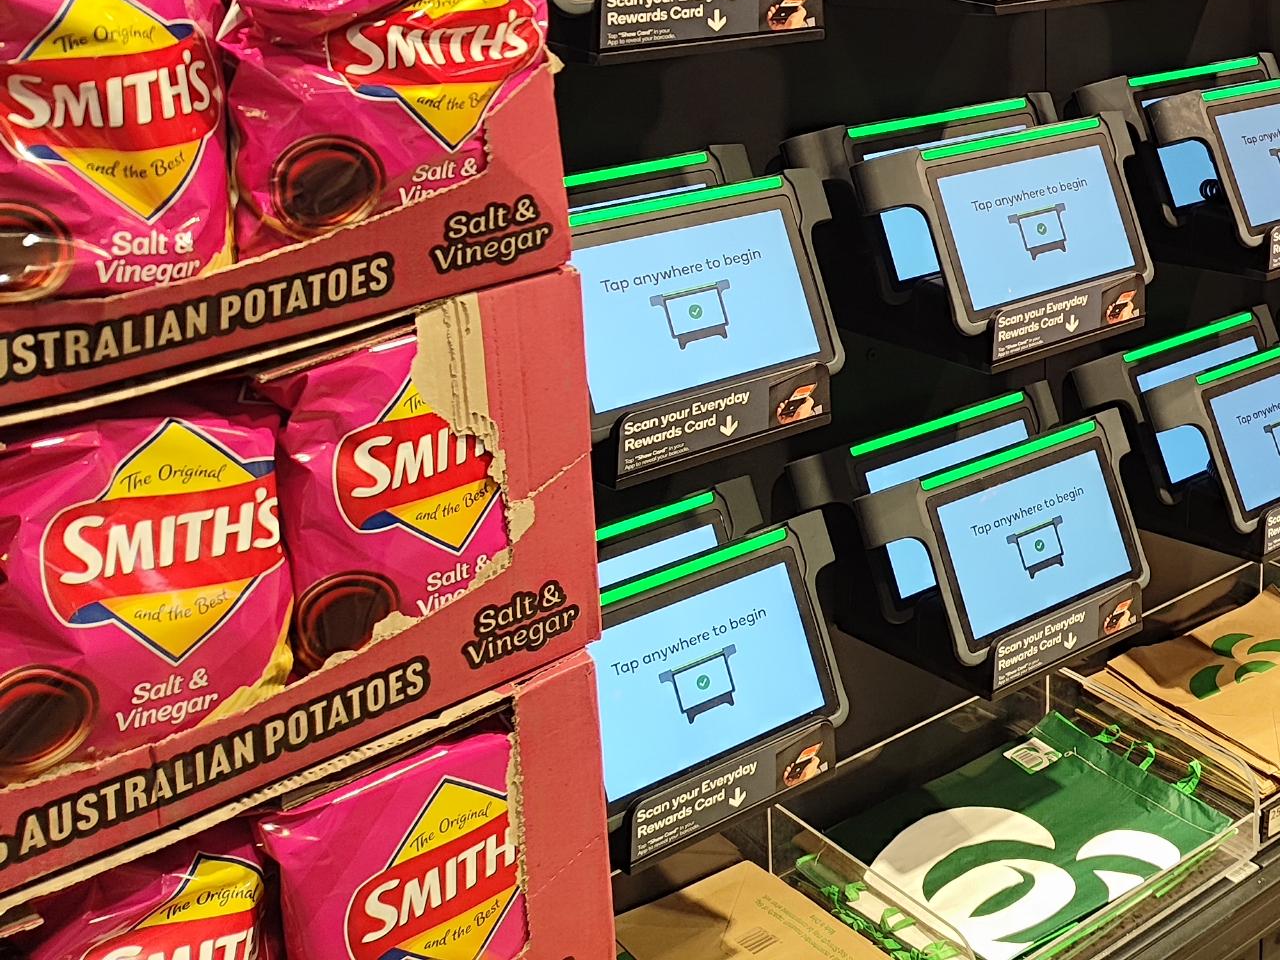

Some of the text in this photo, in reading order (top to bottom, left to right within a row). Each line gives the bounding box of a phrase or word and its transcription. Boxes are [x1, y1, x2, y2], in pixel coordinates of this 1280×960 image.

[606, 5, 704, 26] Rewards Card
[53, 25, 156, 54] The Original
[343, 8, 532, 76] SMITH'S
[7, 49, 210, 129] SMITH'S
[416, 94, 446, 110] and
[446, 97, 466, 111] the
[1242, 135, 1258, 146] Tap
[86, 151, 186, 179] and the Best
[412, 158, 478, 182] Salt &
[971, 177, 1088, 213] Tap anywhere to begin
[448, 198, 536, 240] Salt &
[112, 230, 194, 256] Salt &
[434, 227, 552, 272] Vinegar
[96, 258, 200, 286] Vinegar
[600, 248, 762, 294] Tap anywhere to begin
[220, 257, 390, 331] POTATOES
[998, 294, 1088, 328] Scan your Everyday
[998, 314, 1064, 342] Rewards Card
[624, 390, 750, 436] Scan your Everyday
[624, 414, 717, 452] Rewards Card
[120, 464, 227, 492] The Original
[415, 485, 490, 522] and the Best
[970, 486, 1084, 537] Tap anywhere to begin
[60, 487, 280, 585] SMITH'S
[426, 555, 492, 592] Salt &
[134, 589, 229, 622] and the Best
[478, 584, 563, 634] Salt &
[466, 607, 575, 664] Vinegar
[610, 606, 767, 677] Tap anywhere to begin
[998, 611, 1086, 658] Scan your Everyday
[998, 636, 1062, 670] Rewards Card
[131, 668, 208, 705] Salt &
[116, 691, 218, 732] Vinegar
[20, 662, 424, 855] AUSTRALIAN POTATOES
[636, 760, 758, 823] Scan your Everyday
[410, 802, 492, 852] The Original
[637, 790, 726, 838] Rewards Card
[160, 884, 257, 920] The Original
[424, 898, 502, 950] and the Best
